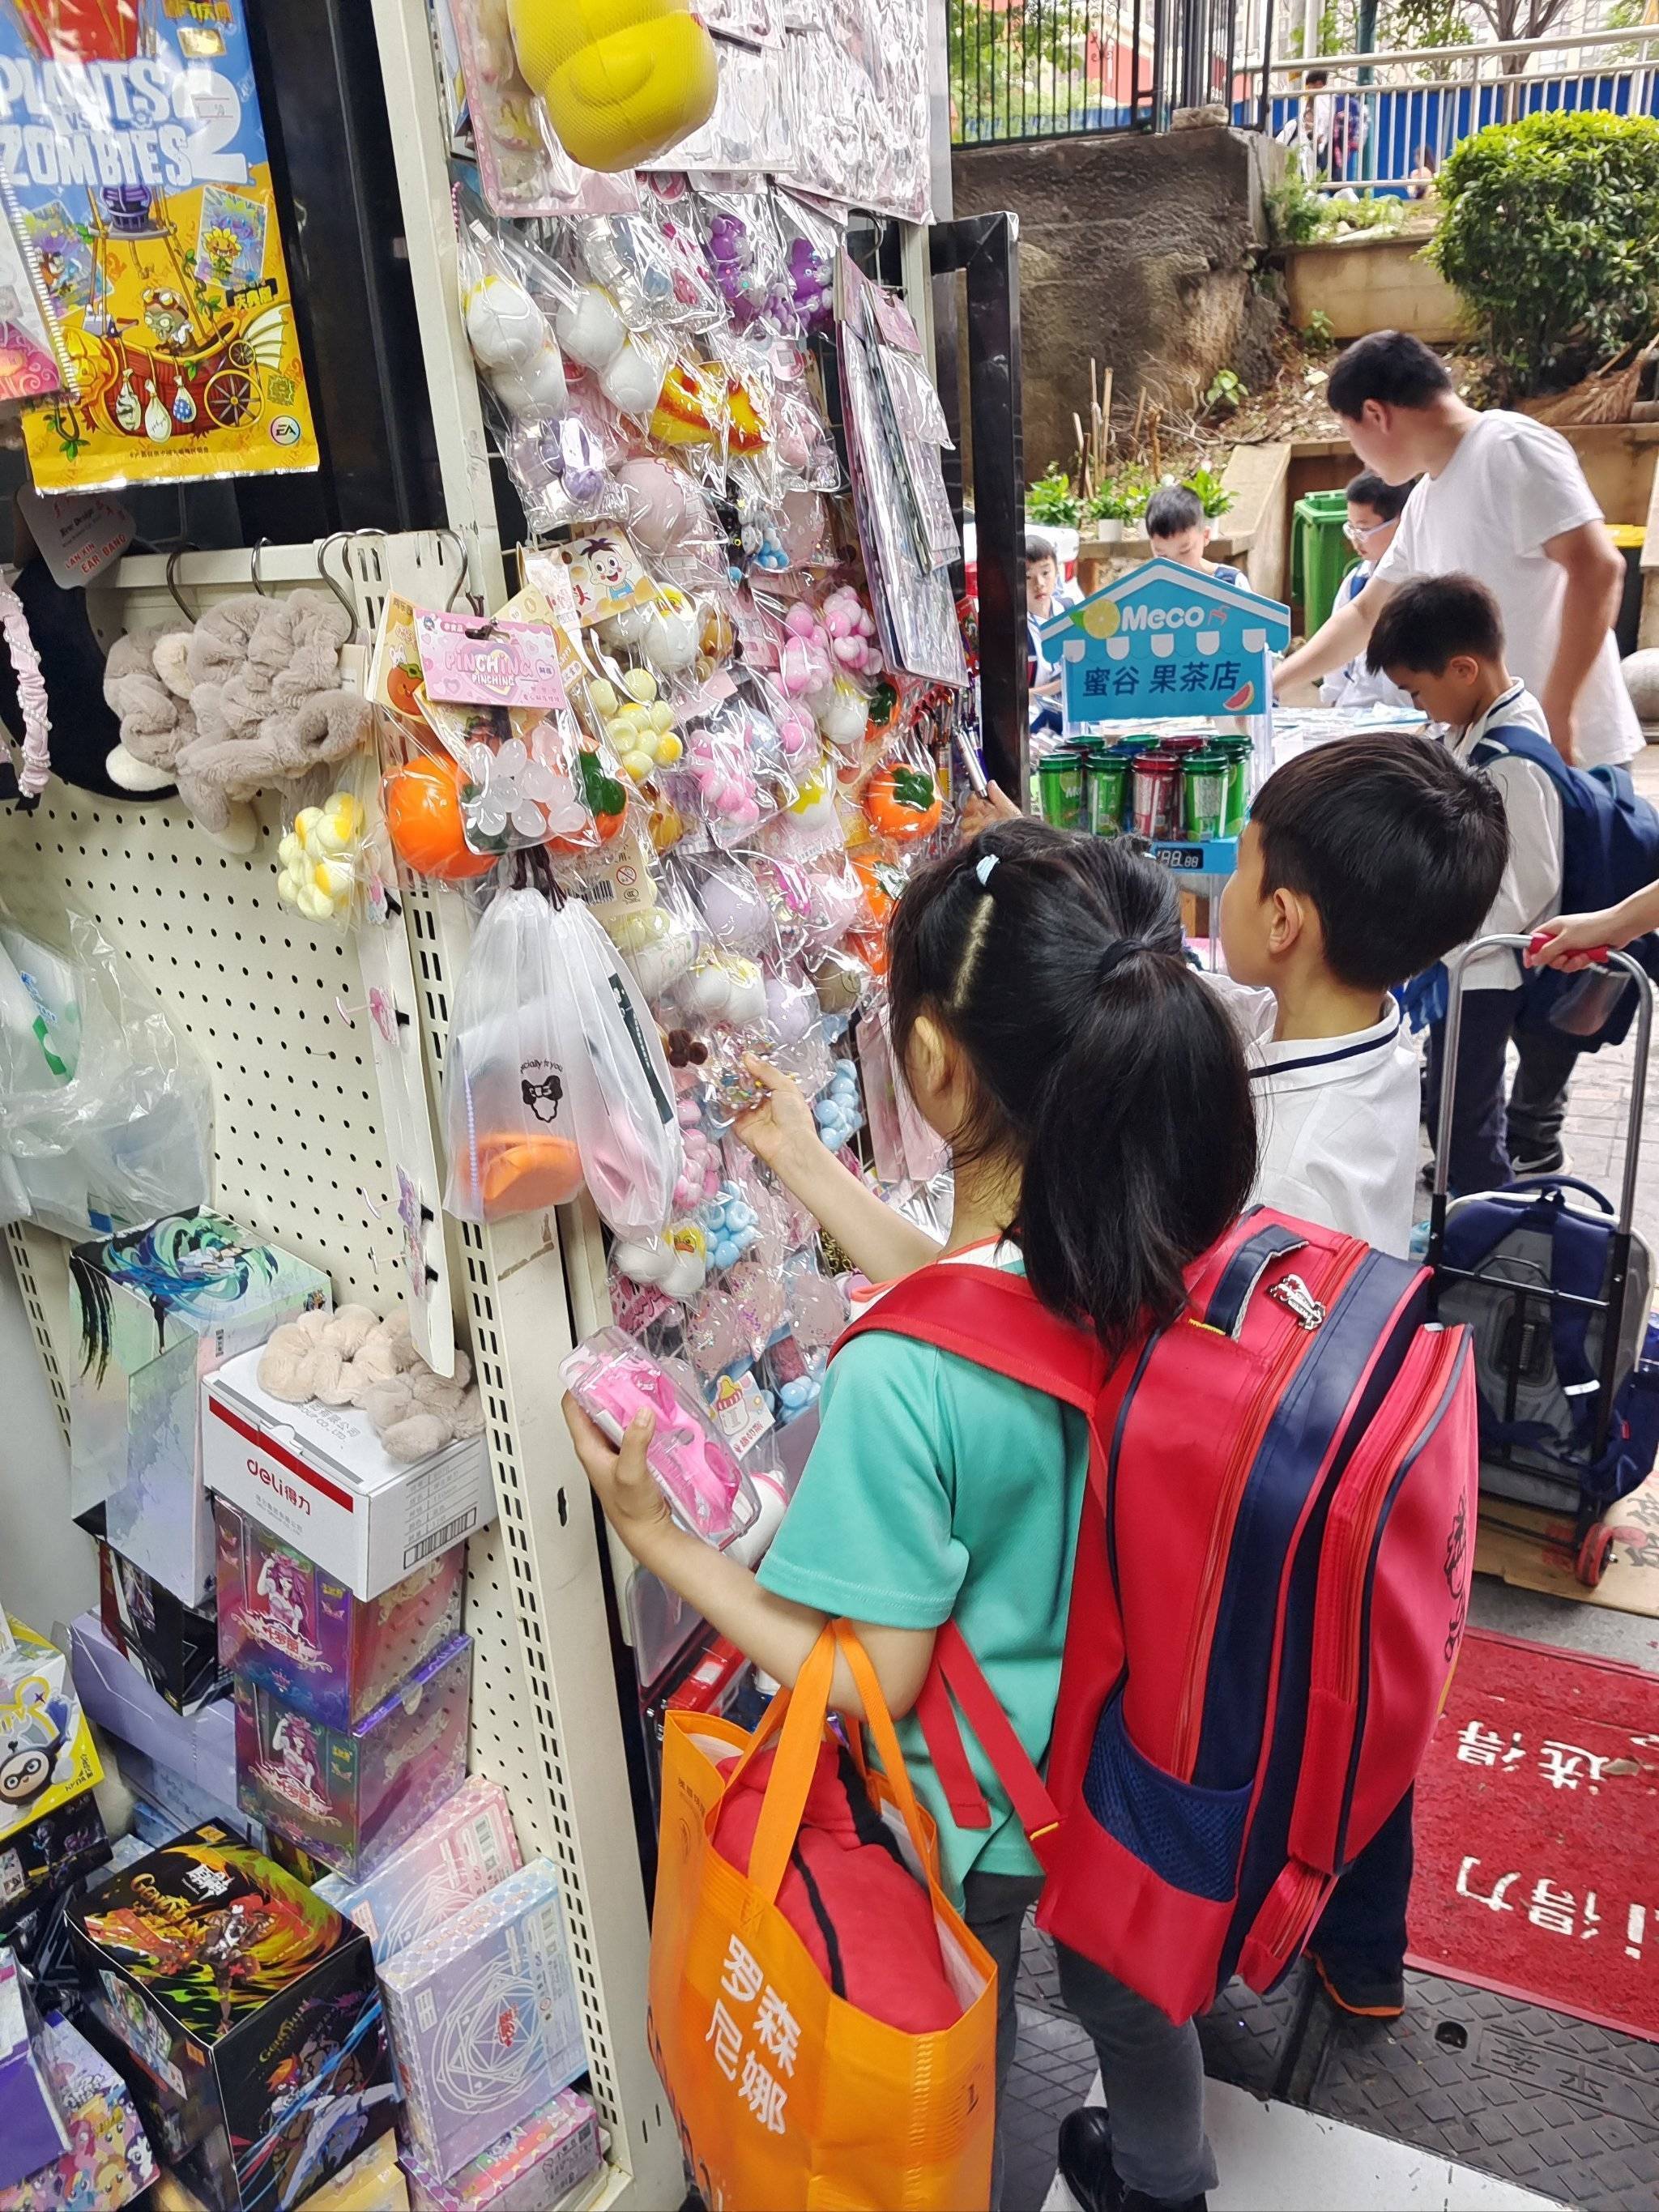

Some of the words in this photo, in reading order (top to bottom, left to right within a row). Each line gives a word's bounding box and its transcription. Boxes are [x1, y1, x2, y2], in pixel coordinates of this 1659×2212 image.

[0, 124, 193, 187] ZOMBIES
[275, 424, 297, 437] EA
[82, 555, 100, 573] EAR
[102, 534, 126, 557] BAND
[1121, 604, 1205, 632] Meco
[446, 649, 533, 677] PINCHING
[471, 674, 516, 687] PINCHING
[1082, 666, 1140, 698] 蜜谷
[1149, 660, 1241, 695] 果茶店
